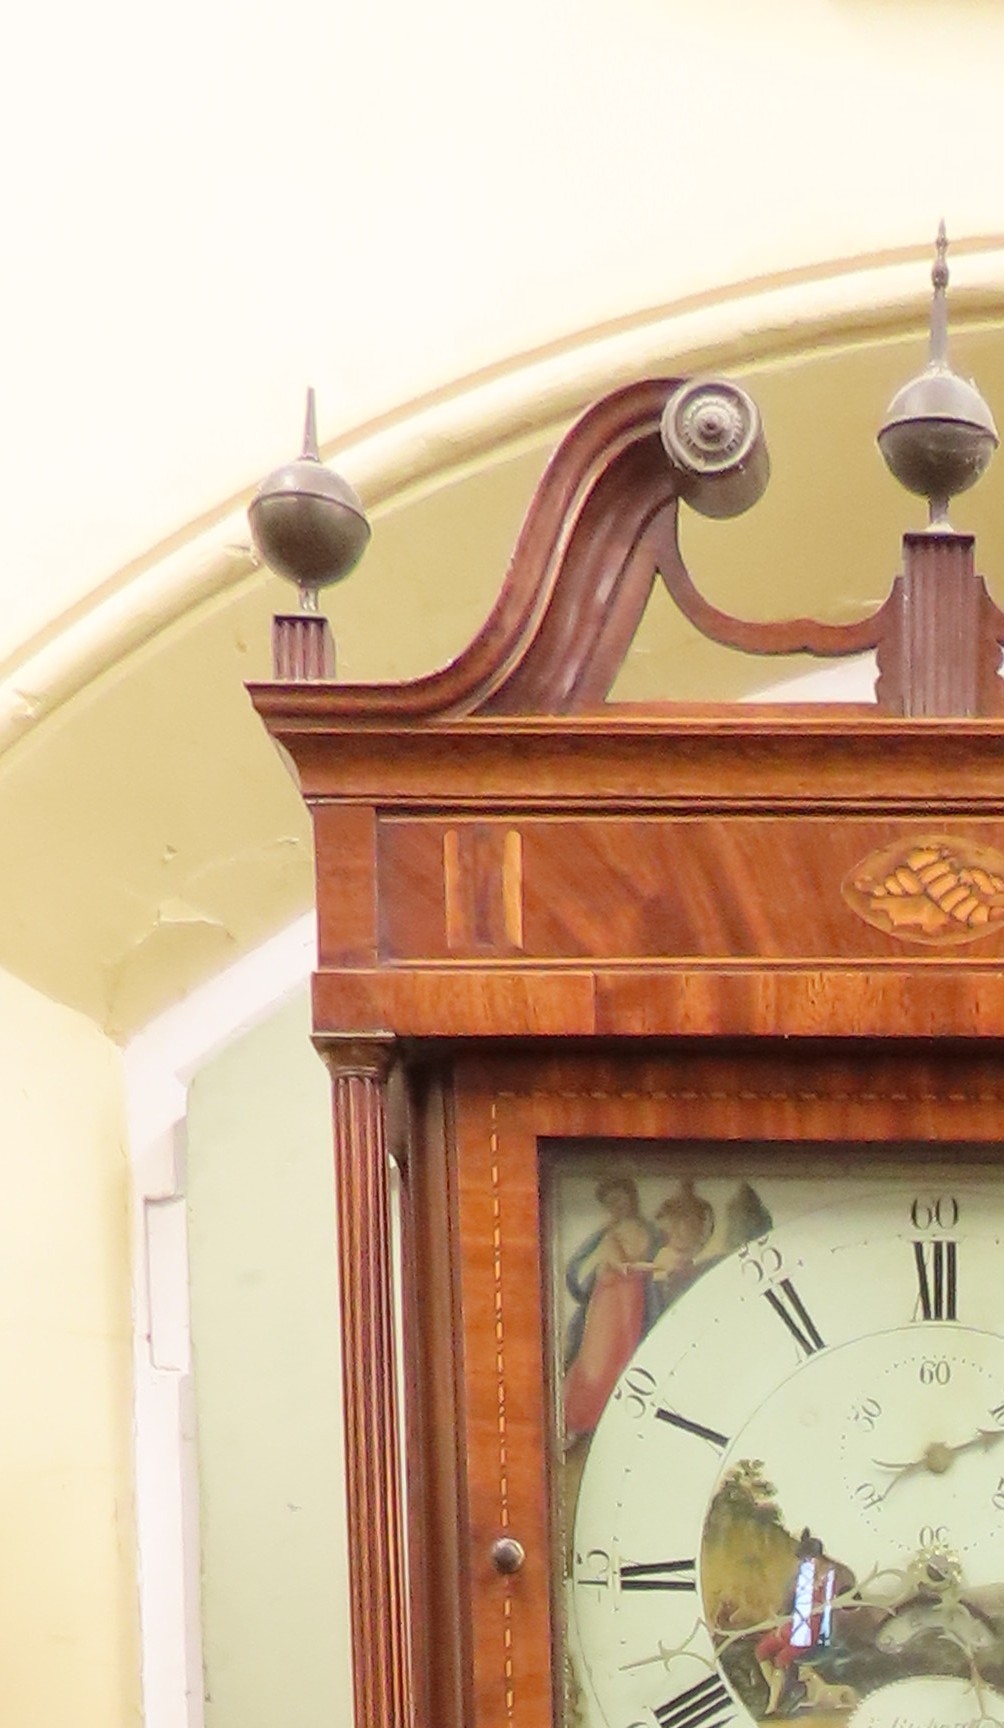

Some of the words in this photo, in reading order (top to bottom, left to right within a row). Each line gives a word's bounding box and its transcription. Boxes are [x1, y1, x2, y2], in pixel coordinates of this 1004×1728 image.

[910, 1195, 960, 1230] 60
[739, 1234, 783, 1283] 55
[614, 1366, 657, 1419] 50
[919, 1360, 951, 1385] 60
